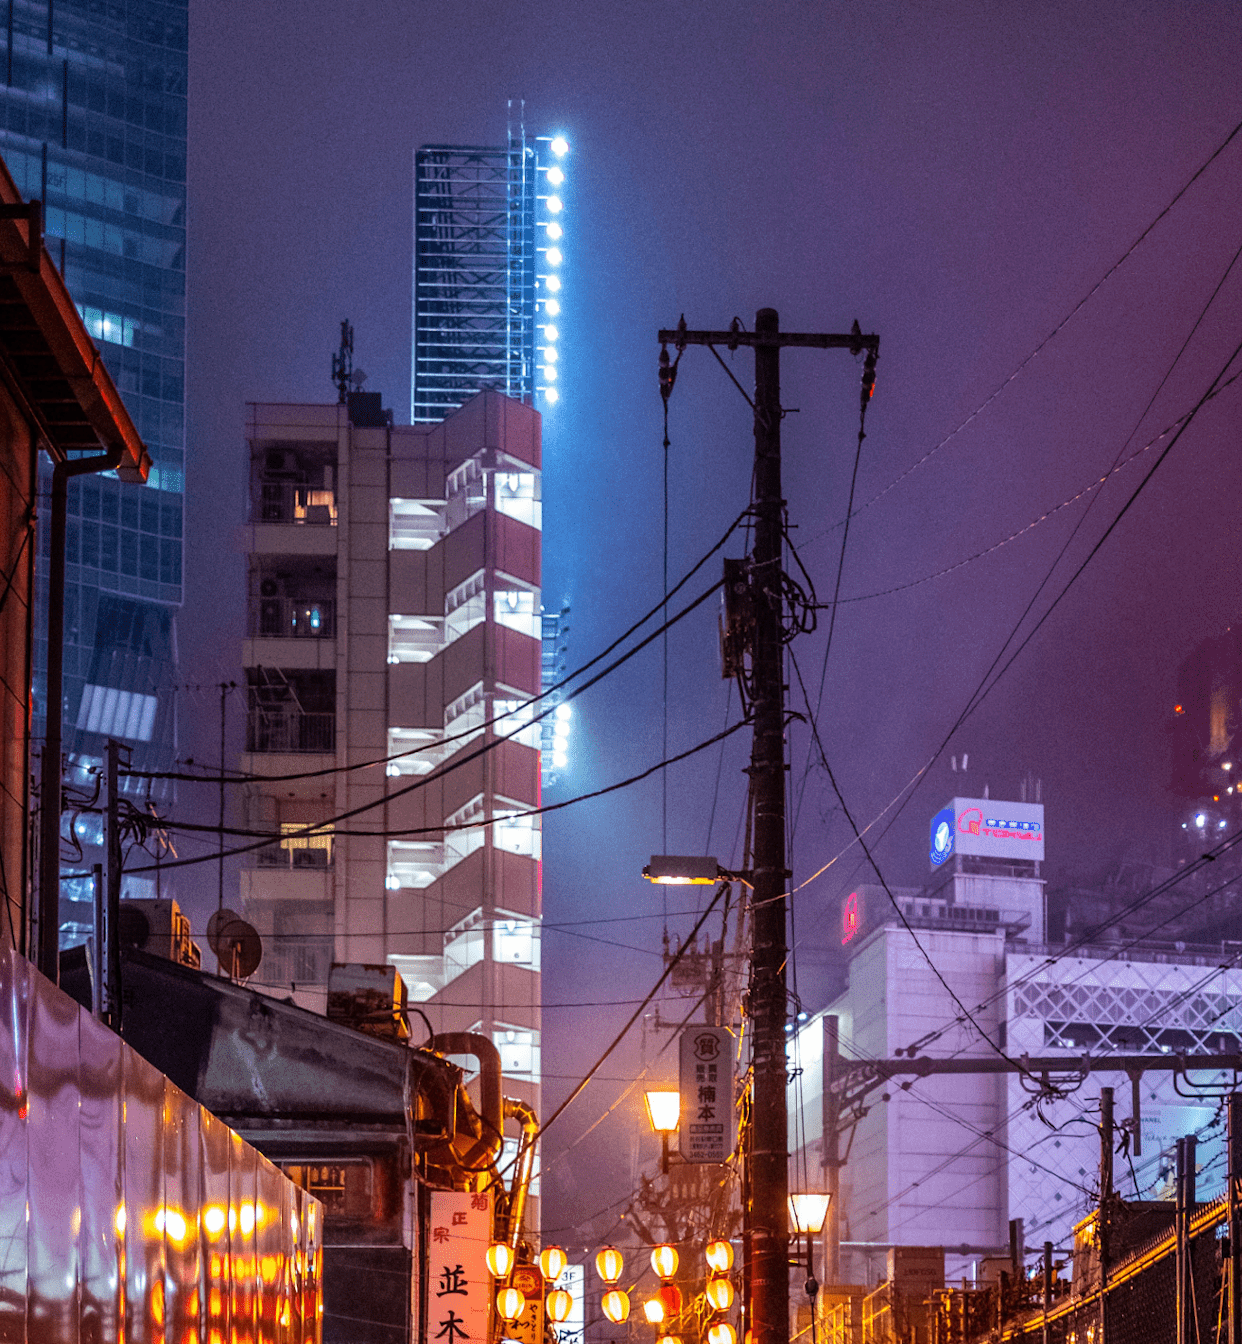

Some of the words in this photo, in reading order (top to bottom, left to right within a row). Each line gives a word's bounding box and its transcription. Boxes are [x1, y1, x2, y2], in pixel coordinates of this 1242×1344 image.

[697, 1085, 716, 1122] 楠本
[561, 1271, 576, 1281] 3F
[529, 1303, 538, 1342] やきとり
